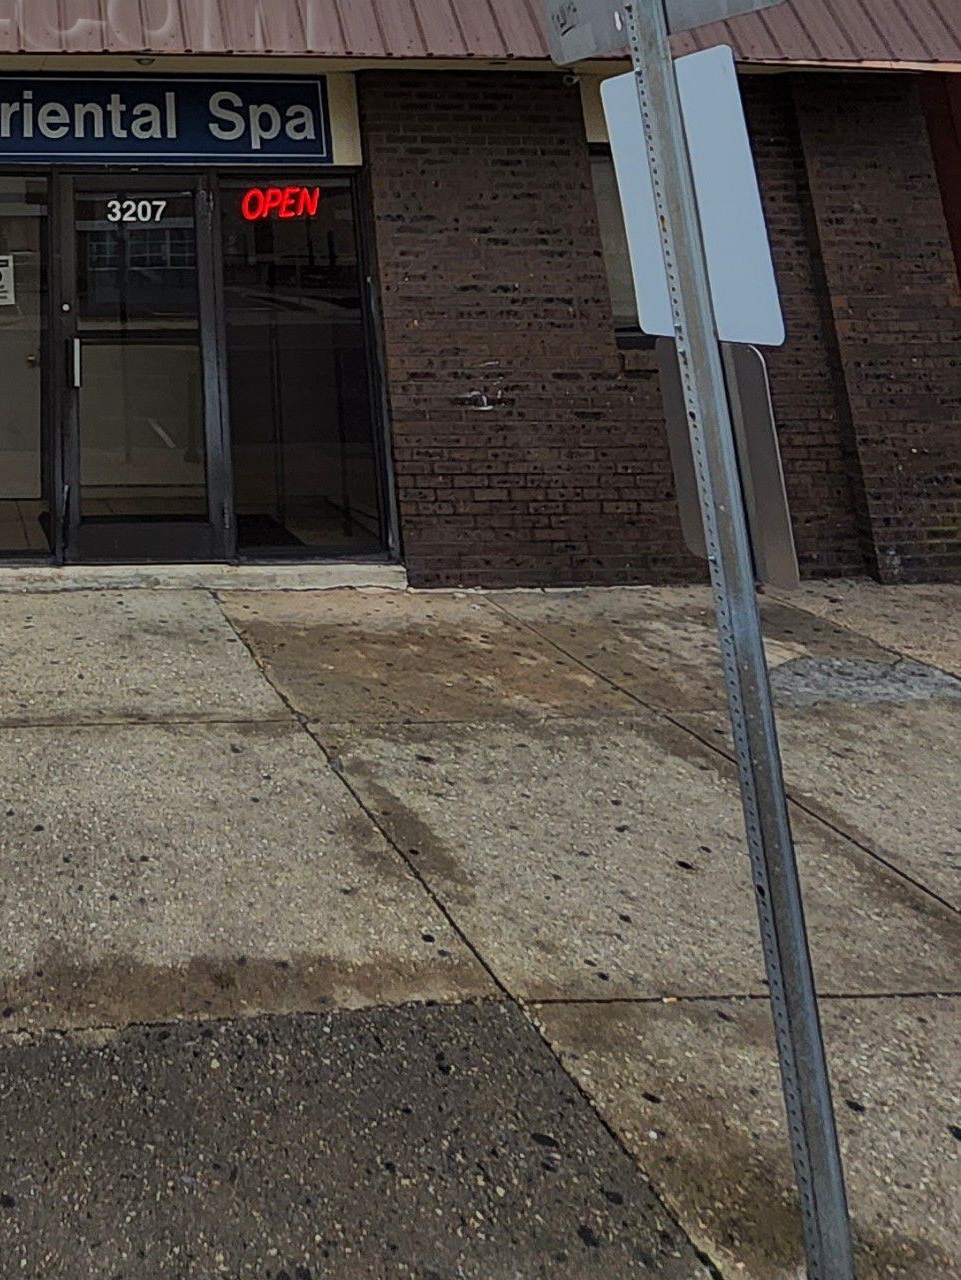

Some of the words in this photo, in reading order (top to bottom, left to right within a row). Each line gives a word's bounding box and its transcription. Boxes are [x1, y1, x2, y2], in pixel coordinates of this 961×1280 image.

[208, 91, 316, 149] Spa
[106, 200, 167, 223] 3207
[241, 187, 320, 221] OPEN
